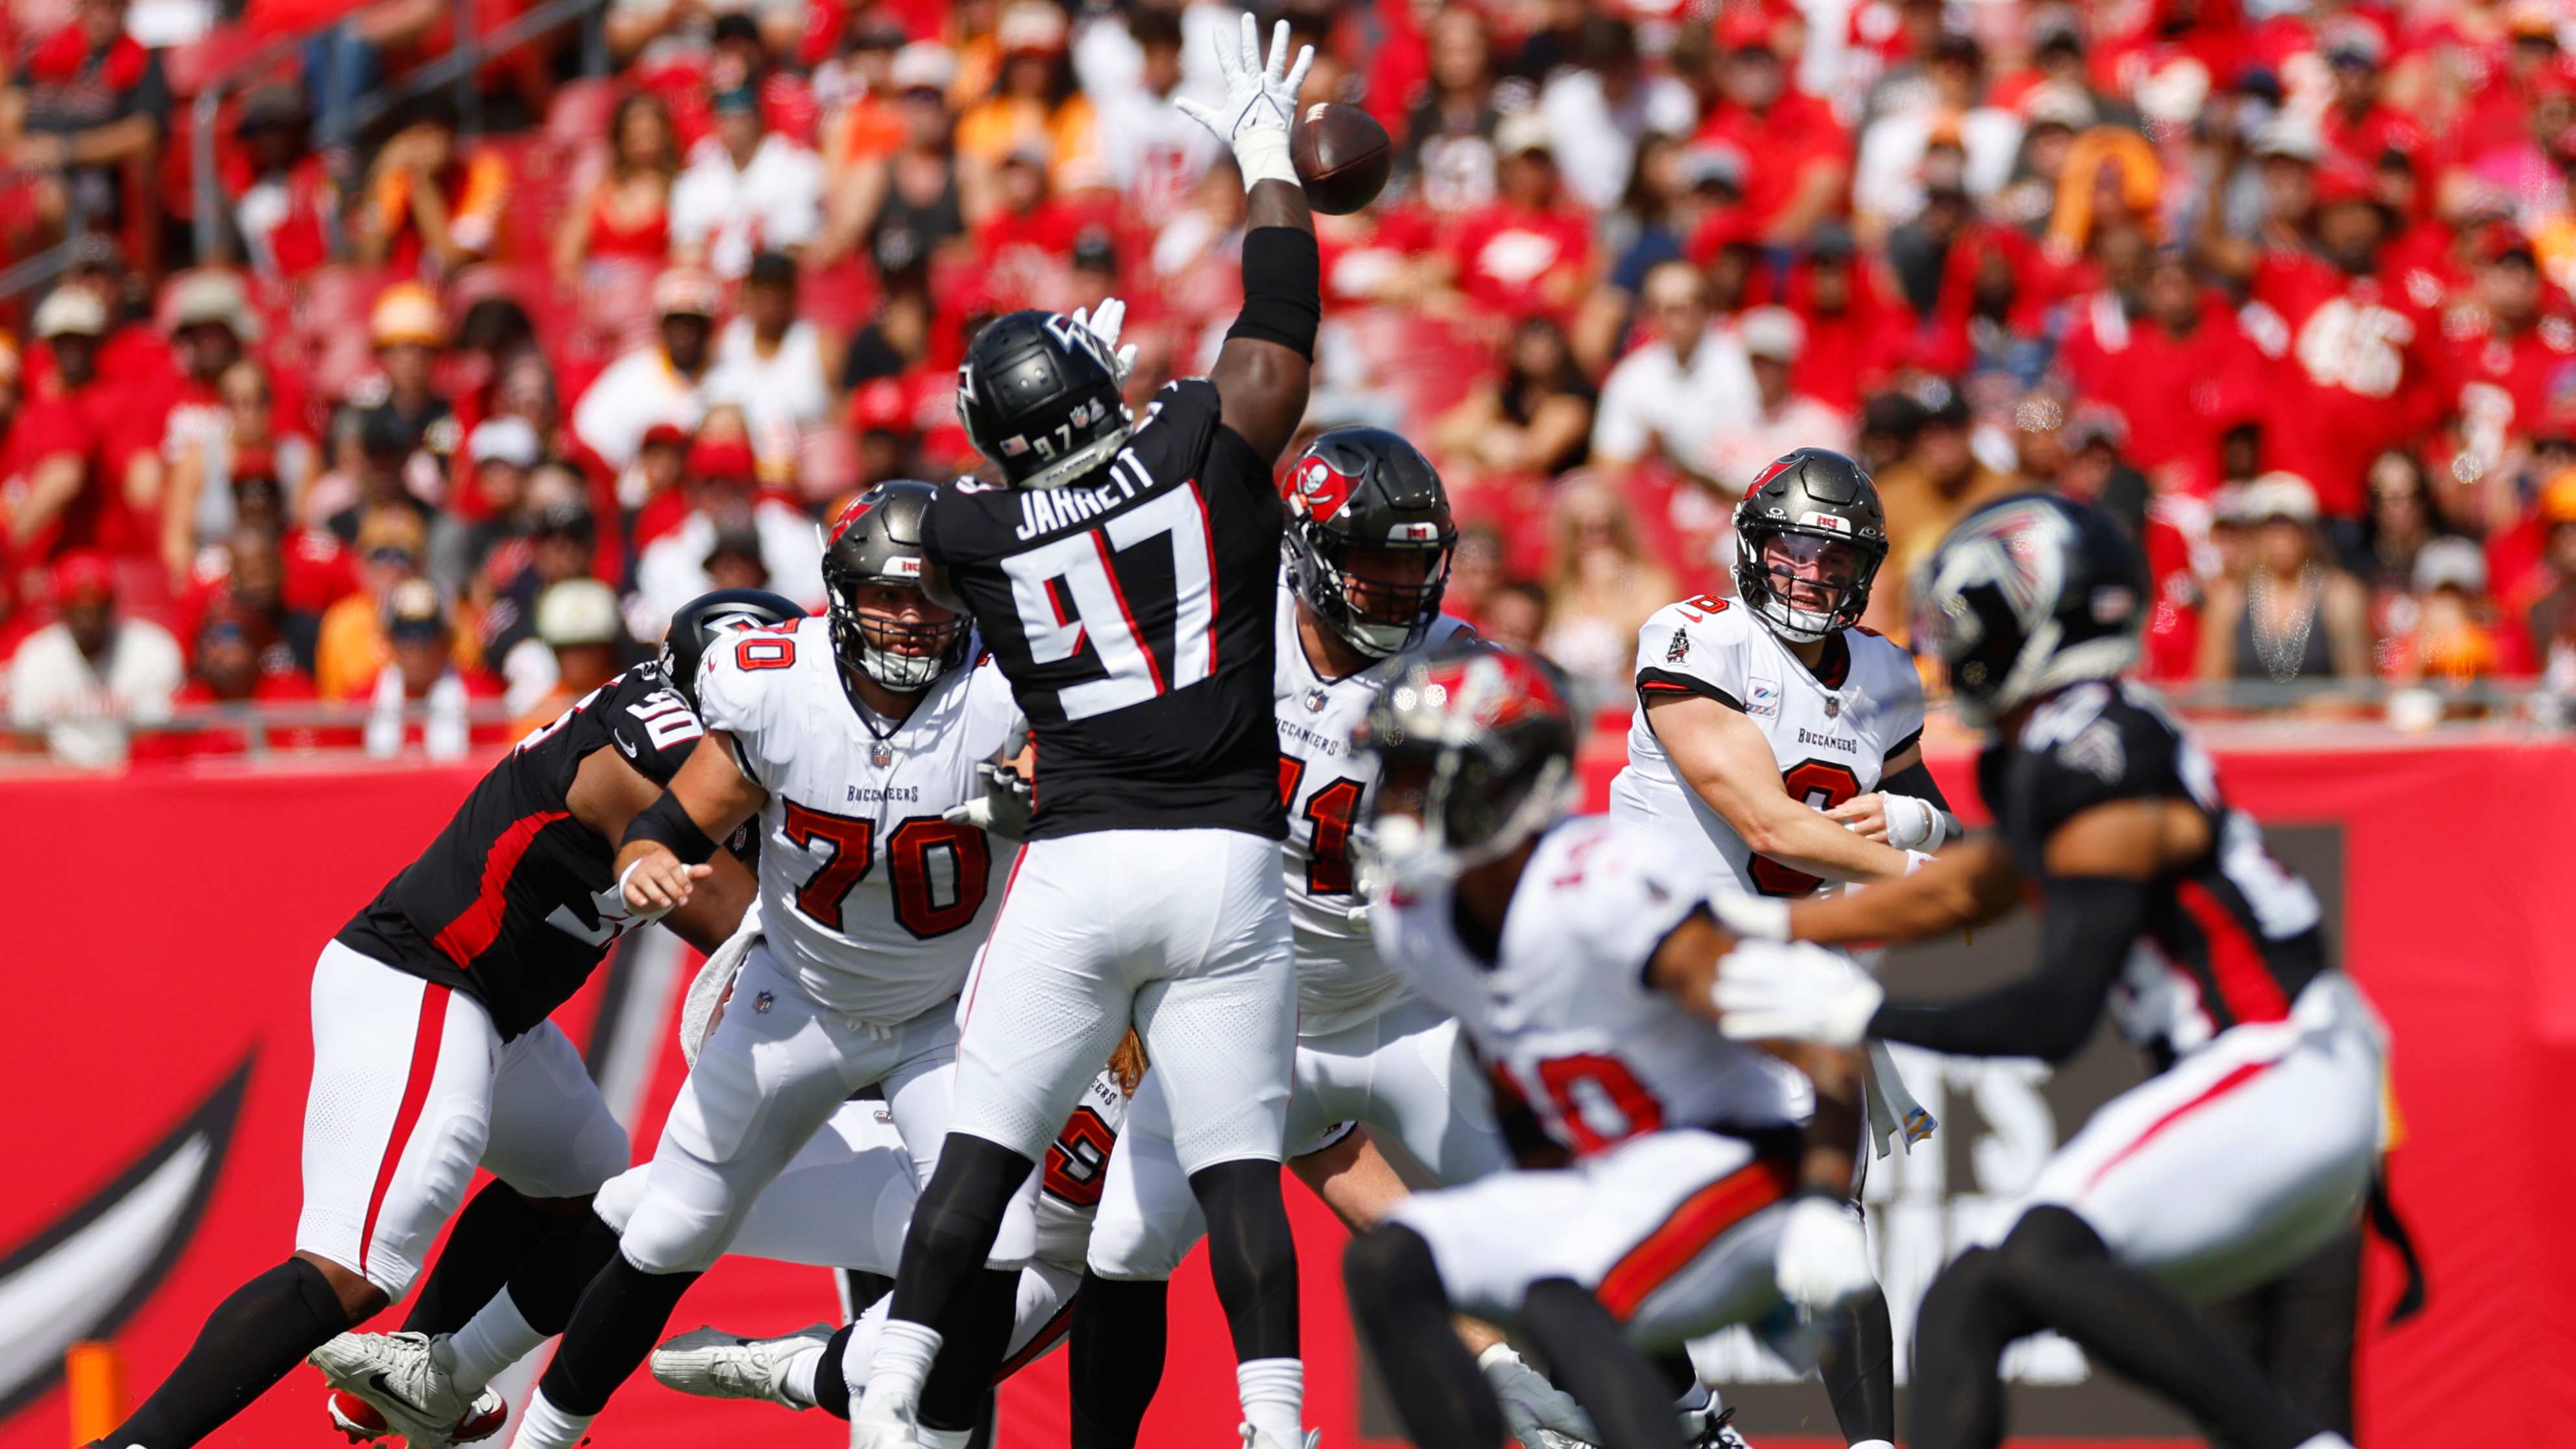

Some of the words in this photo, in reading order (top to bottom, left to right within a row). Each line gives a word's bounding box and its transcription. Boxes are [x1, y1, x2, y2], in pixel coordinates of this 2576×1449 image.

[1033, 423, 1071, 462] 97
[1016, 447, 1154, 541] JARRETT
[1000, 478, 1219, 721] 97
[1276, 717, 1339, 756] CCANEERS
[1798, 727, 1857, 754] BUCCANEERS
[784, 797, 991, 939] 70
